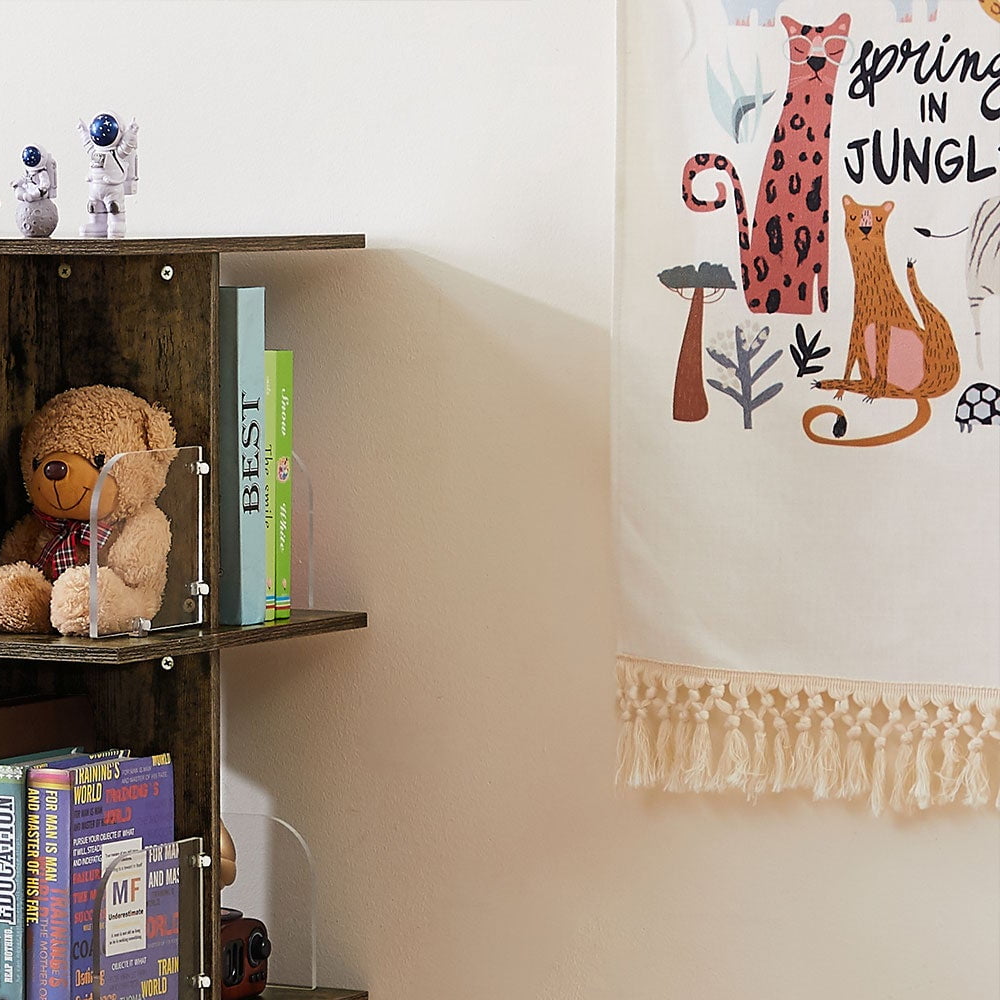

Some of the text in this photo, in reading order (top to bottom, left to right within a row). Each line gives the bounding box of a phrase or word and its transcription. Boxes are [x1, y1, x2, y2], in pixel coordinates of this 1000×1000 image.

[920, 92, 947, 123] IN
[844, 127, 1000, 184] JUNGL
[242, 389, 260, 514] BEST
[279, 388, 290, 552] Snow White
[74, 762, 120, 785] TRAINING'S
[74, 782, 103, 805] WORLD
[45, 789, 58, 882] FOR MAN IS MAN
[26, 787, 40, 927] AND MASTER OF HIS FATE.
[148, 871, 164, 889] AND
[108, 908, 144, 920] Underestimate
[40, 917, 49, 939] THE
[4, 963, 13, 983] REAP
[39, 941, 49, 986] MOTHER
[141, 977, 167, 998] WORLD
